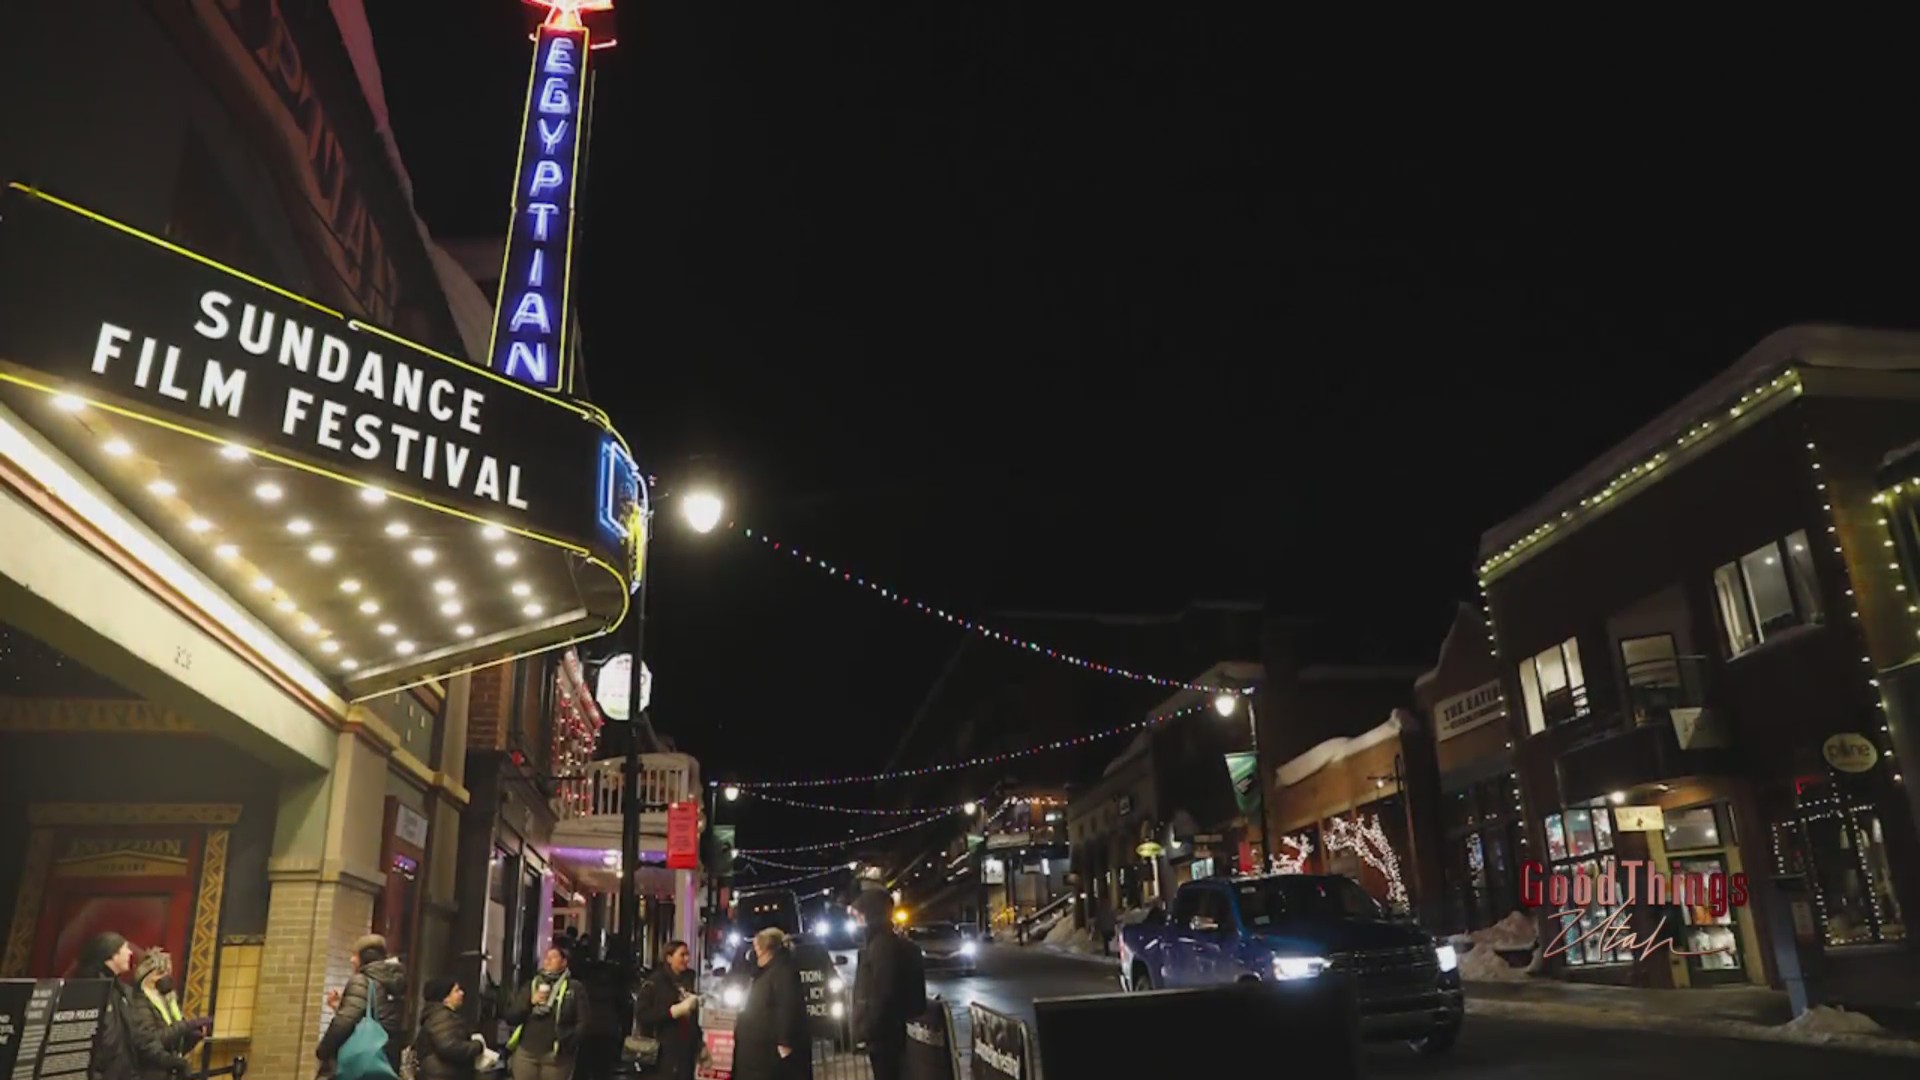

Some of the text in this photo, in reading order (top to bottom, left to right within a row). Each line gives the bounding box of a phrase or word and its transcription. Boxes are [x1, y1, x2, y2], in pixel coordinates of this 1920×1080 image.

[505, 37, 574, 383] EGYPTIAN
[91, 322, 529, 510] FILM FESTIVAL
[194, 291, 485, 435] SUNDANCE
